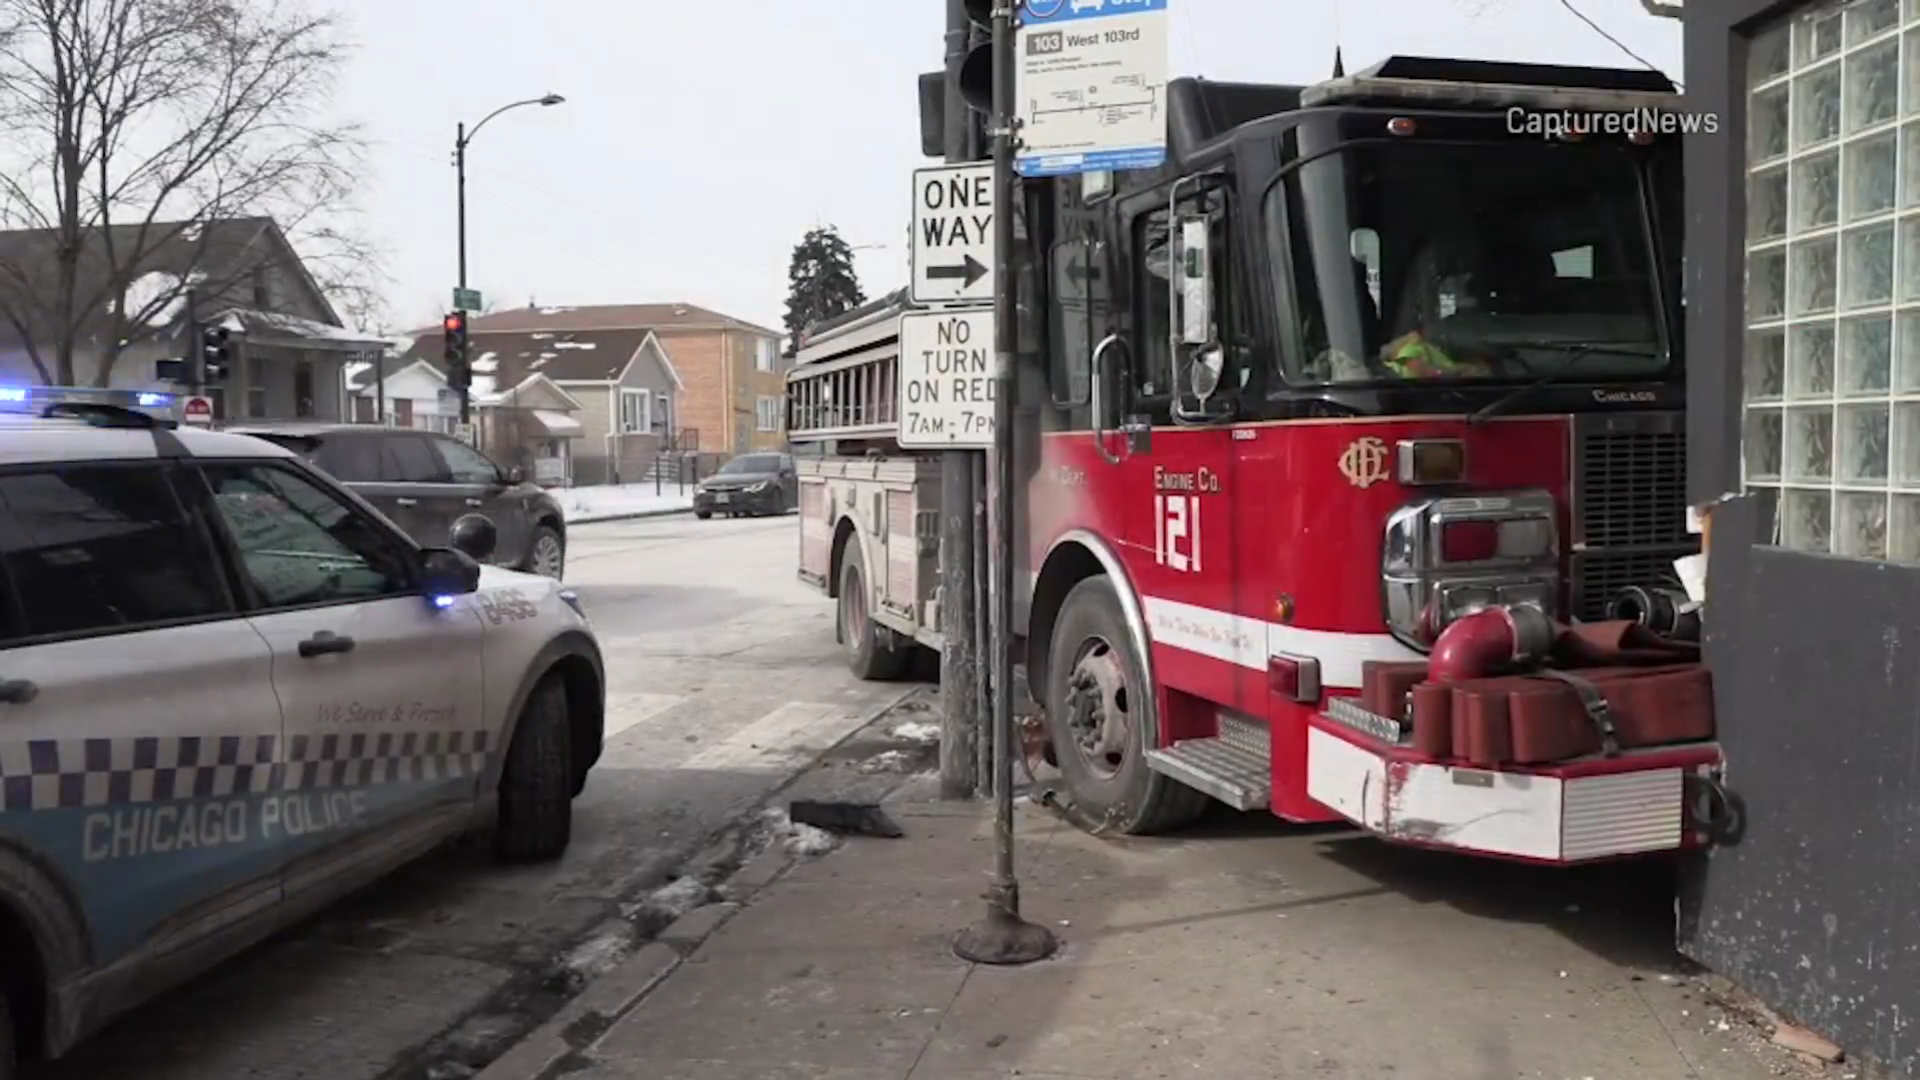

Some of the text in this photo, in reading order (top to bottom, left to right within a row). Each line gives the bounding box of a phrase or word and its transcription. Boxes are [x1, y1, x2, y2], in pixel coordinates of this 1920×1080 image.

[1033, 28, 1140, 52] 103 West 103rd
[924, 176, 992, 210] ONE
[922, 213, 993, 247] WAY
[937, 319, 970, 345] NO
[922, 348, 986, 374] TURN
[907, 379, 939, 403] ON
[1154, 494, 1202, 572] 121
[82, 790, 368, 862] CHICAGO POLICE
